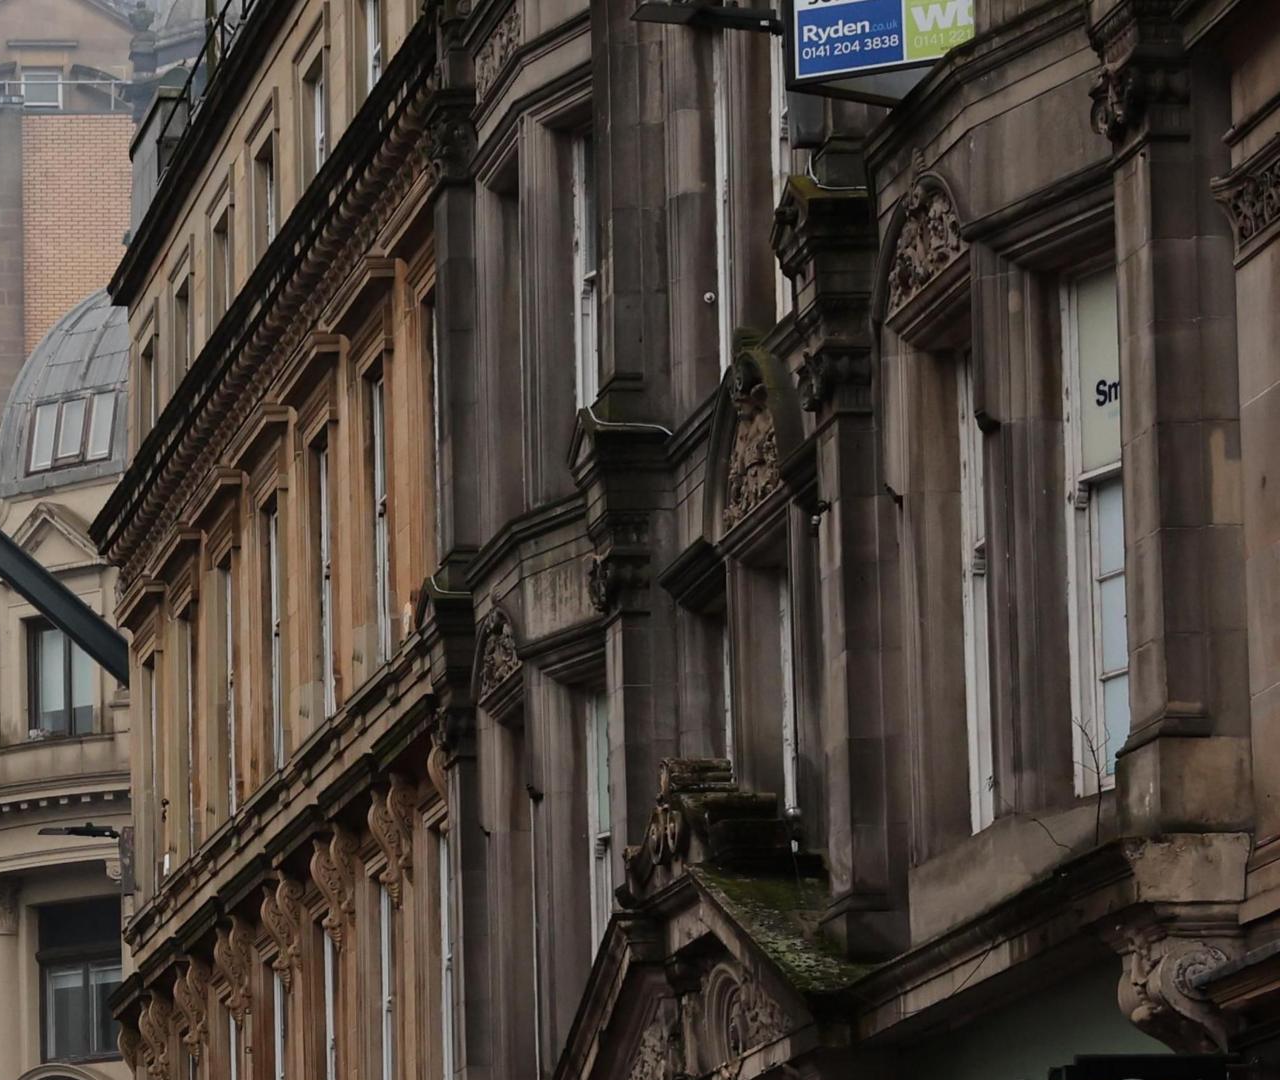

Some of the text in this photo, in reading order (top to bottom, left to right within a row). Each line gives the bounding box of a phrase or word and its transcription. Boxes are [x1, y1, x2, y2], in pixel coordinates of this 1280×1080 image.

[802, 33, 900, 60] 0141 204 3838
[913, 32, 944, 49] 0141
